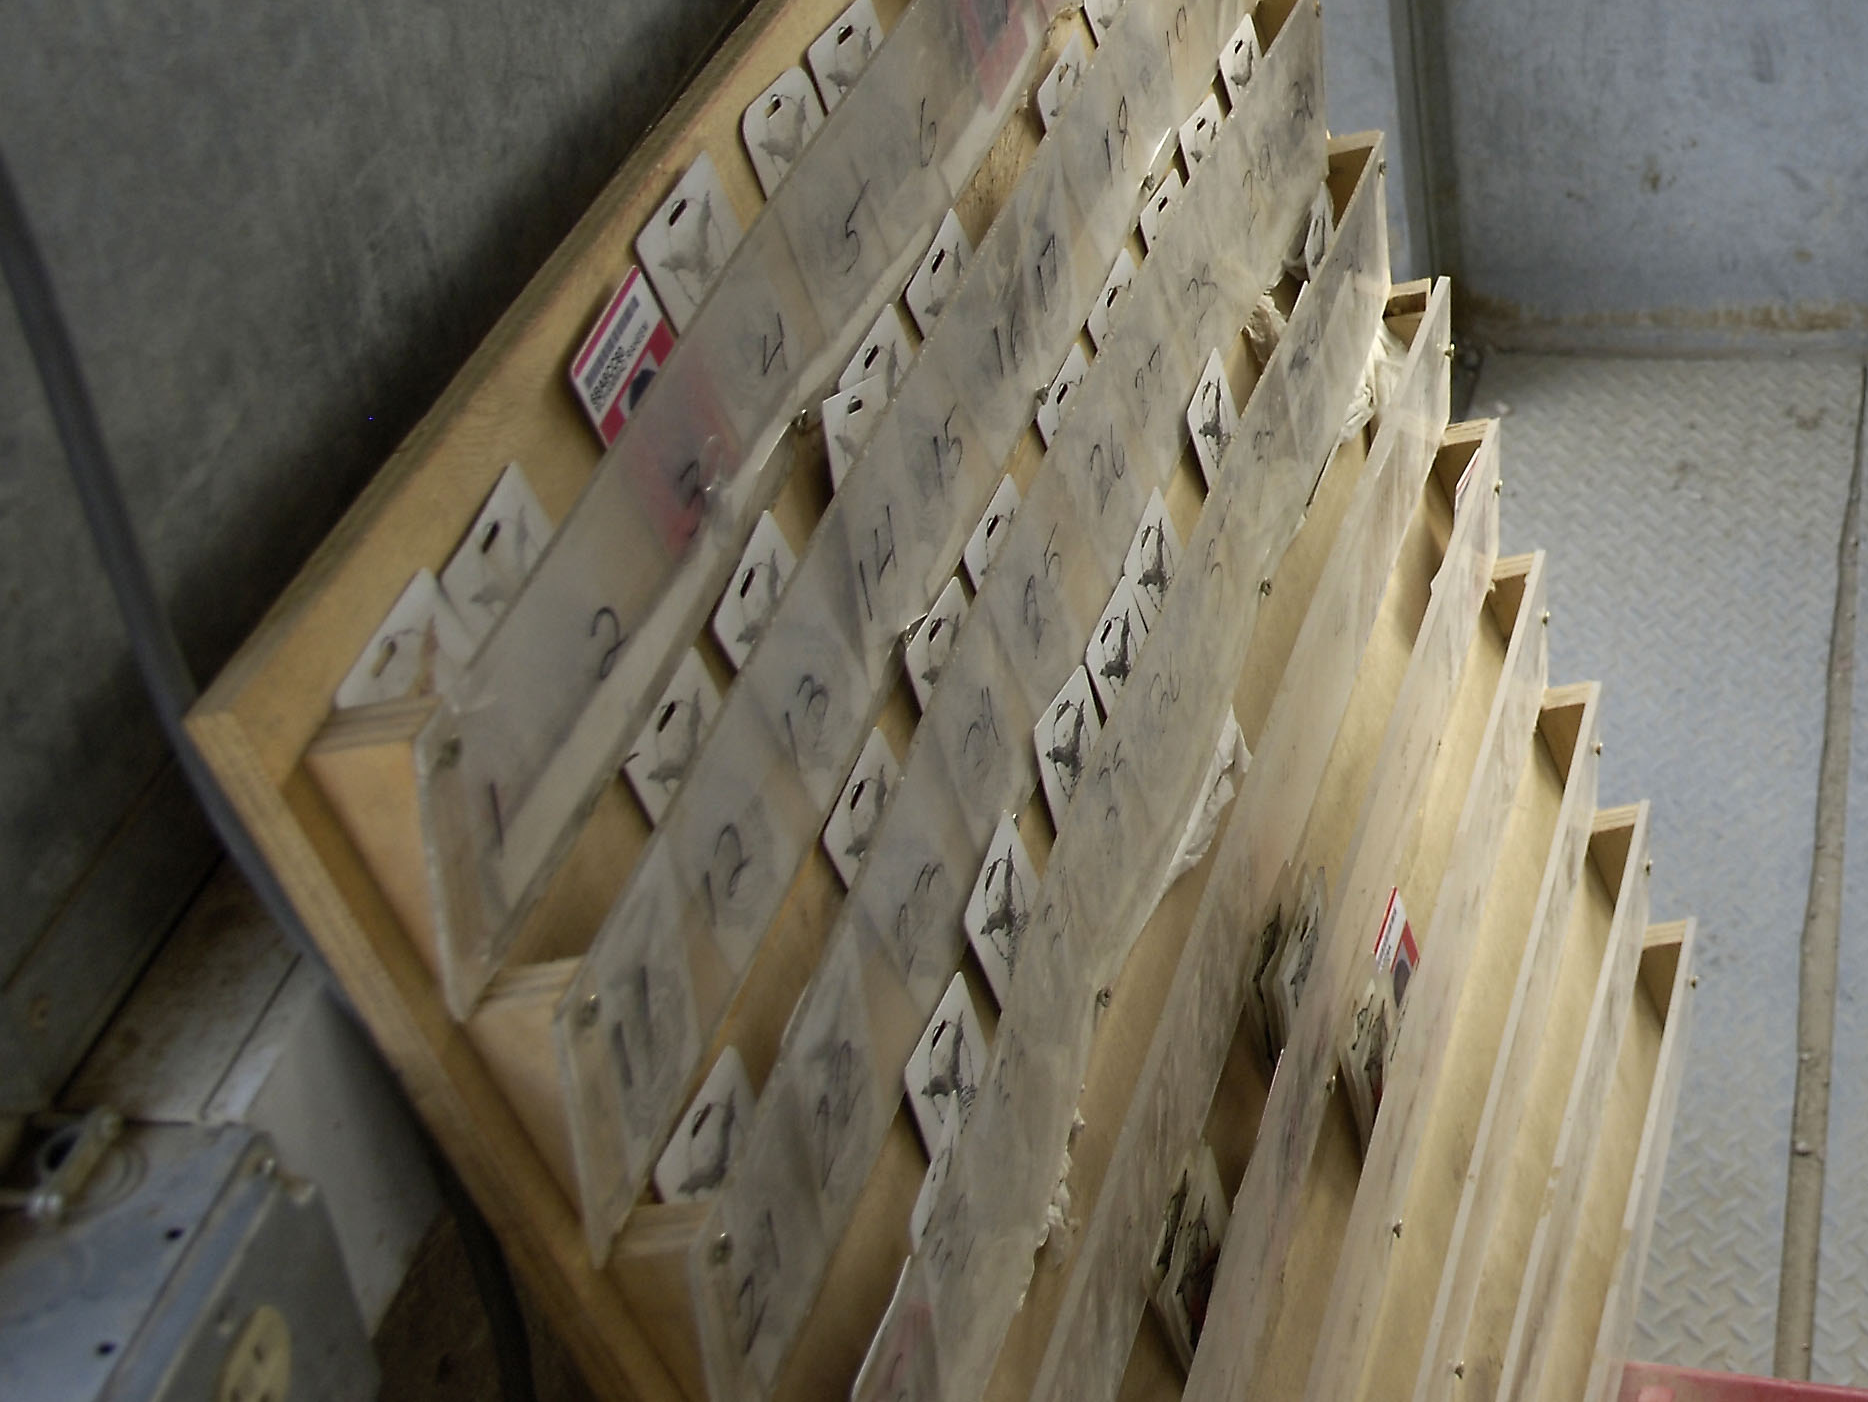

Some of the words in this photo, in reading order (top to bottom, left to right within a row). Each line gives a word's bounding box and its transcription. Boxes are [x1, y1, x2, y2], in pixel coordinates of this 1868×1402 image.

[919, 95, 938, 169] 6
[843, 178, 870, 276] 5
[761, 311, 789, 377] 4
[932, 402, 964, 495] 15
[858, 503, 899, 622] 14
[589, 605, 629, 680] 2
[783, 672, 831, 772] 13
[701, 821, 754, 928] 12
